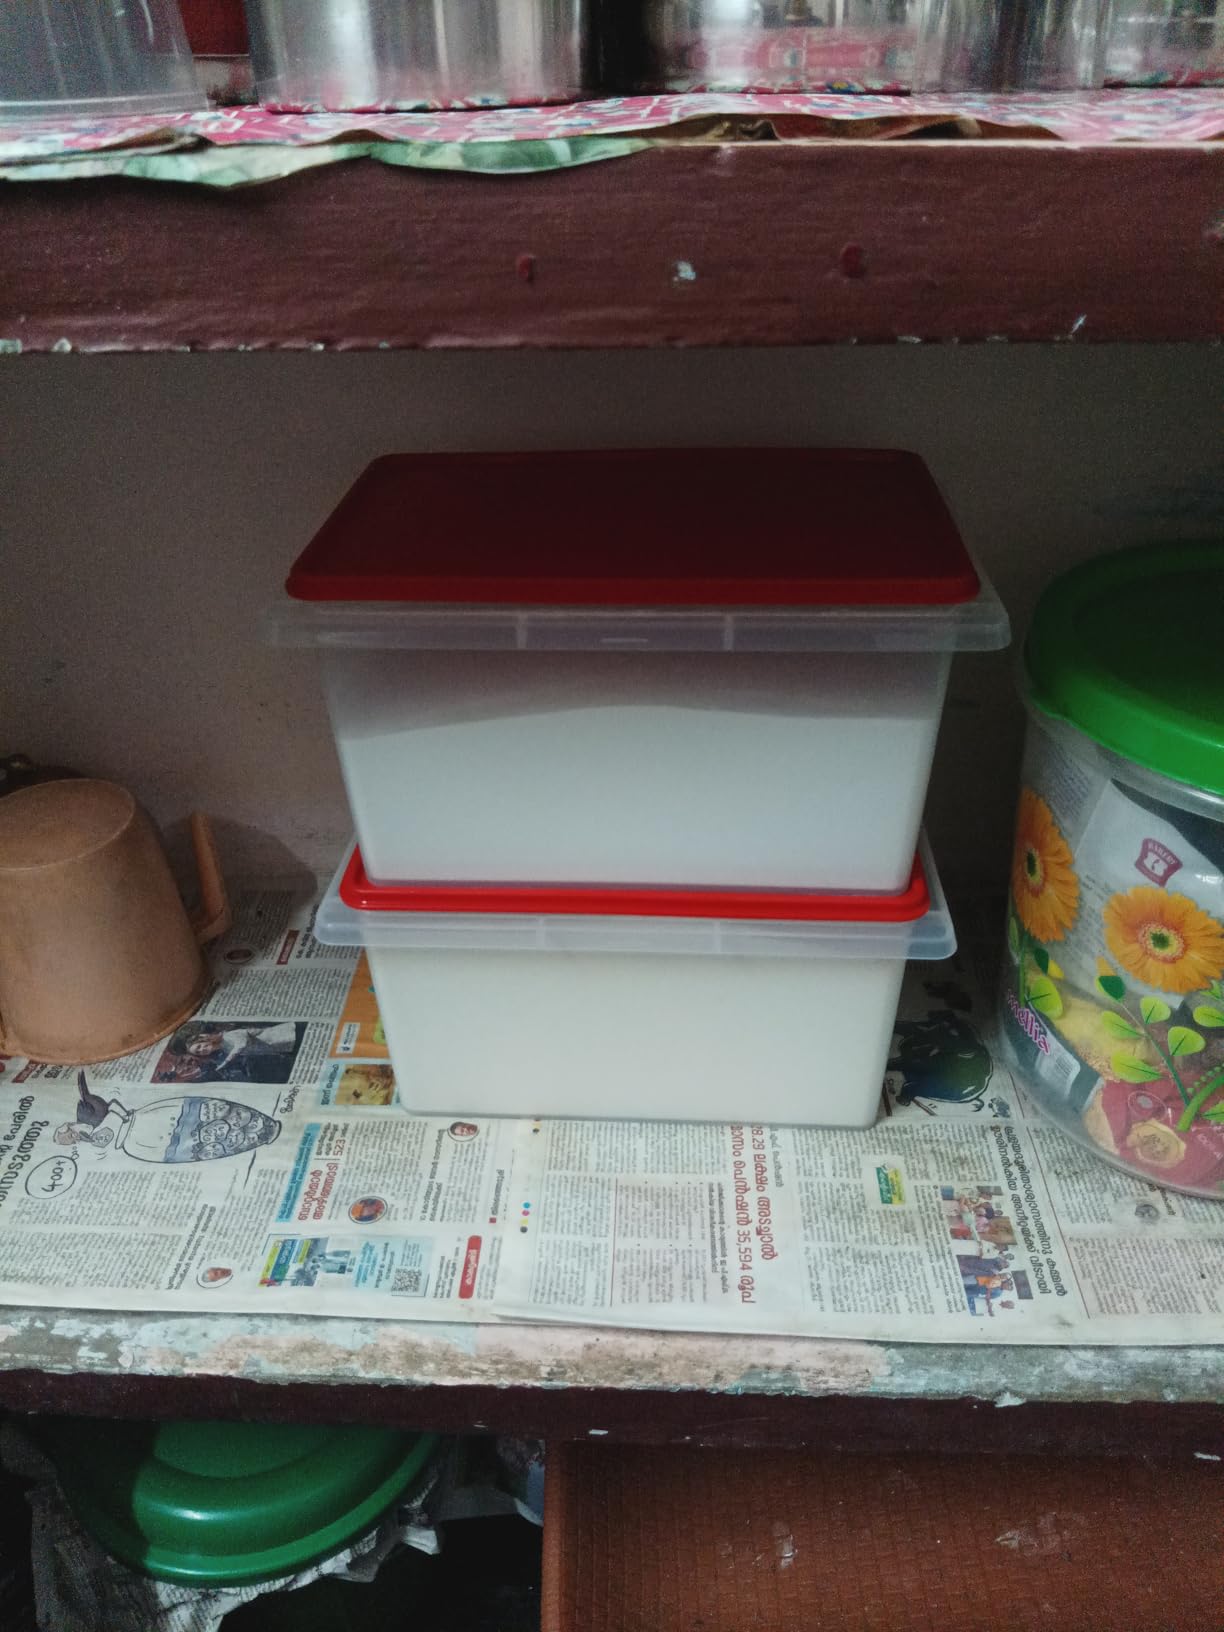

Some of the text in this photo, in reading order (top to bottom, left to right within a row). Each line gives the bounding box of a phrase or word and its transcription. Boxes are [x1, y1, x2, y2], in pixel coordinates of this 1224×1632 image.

[3, 1095, 35, 1141] പേരിൽ
[332, 1138, 346, 1157] 523
[733, 1160, 753, 1227] പെൻഷൻ
[753, 1153, 769, 1193] ലക്ഷം
[755, 1196, 779, 1261] അടച്ചാൽ
[736, 1229, 753, 1272] 35,594
[737, 1274, 757, 1304] രൂപ
